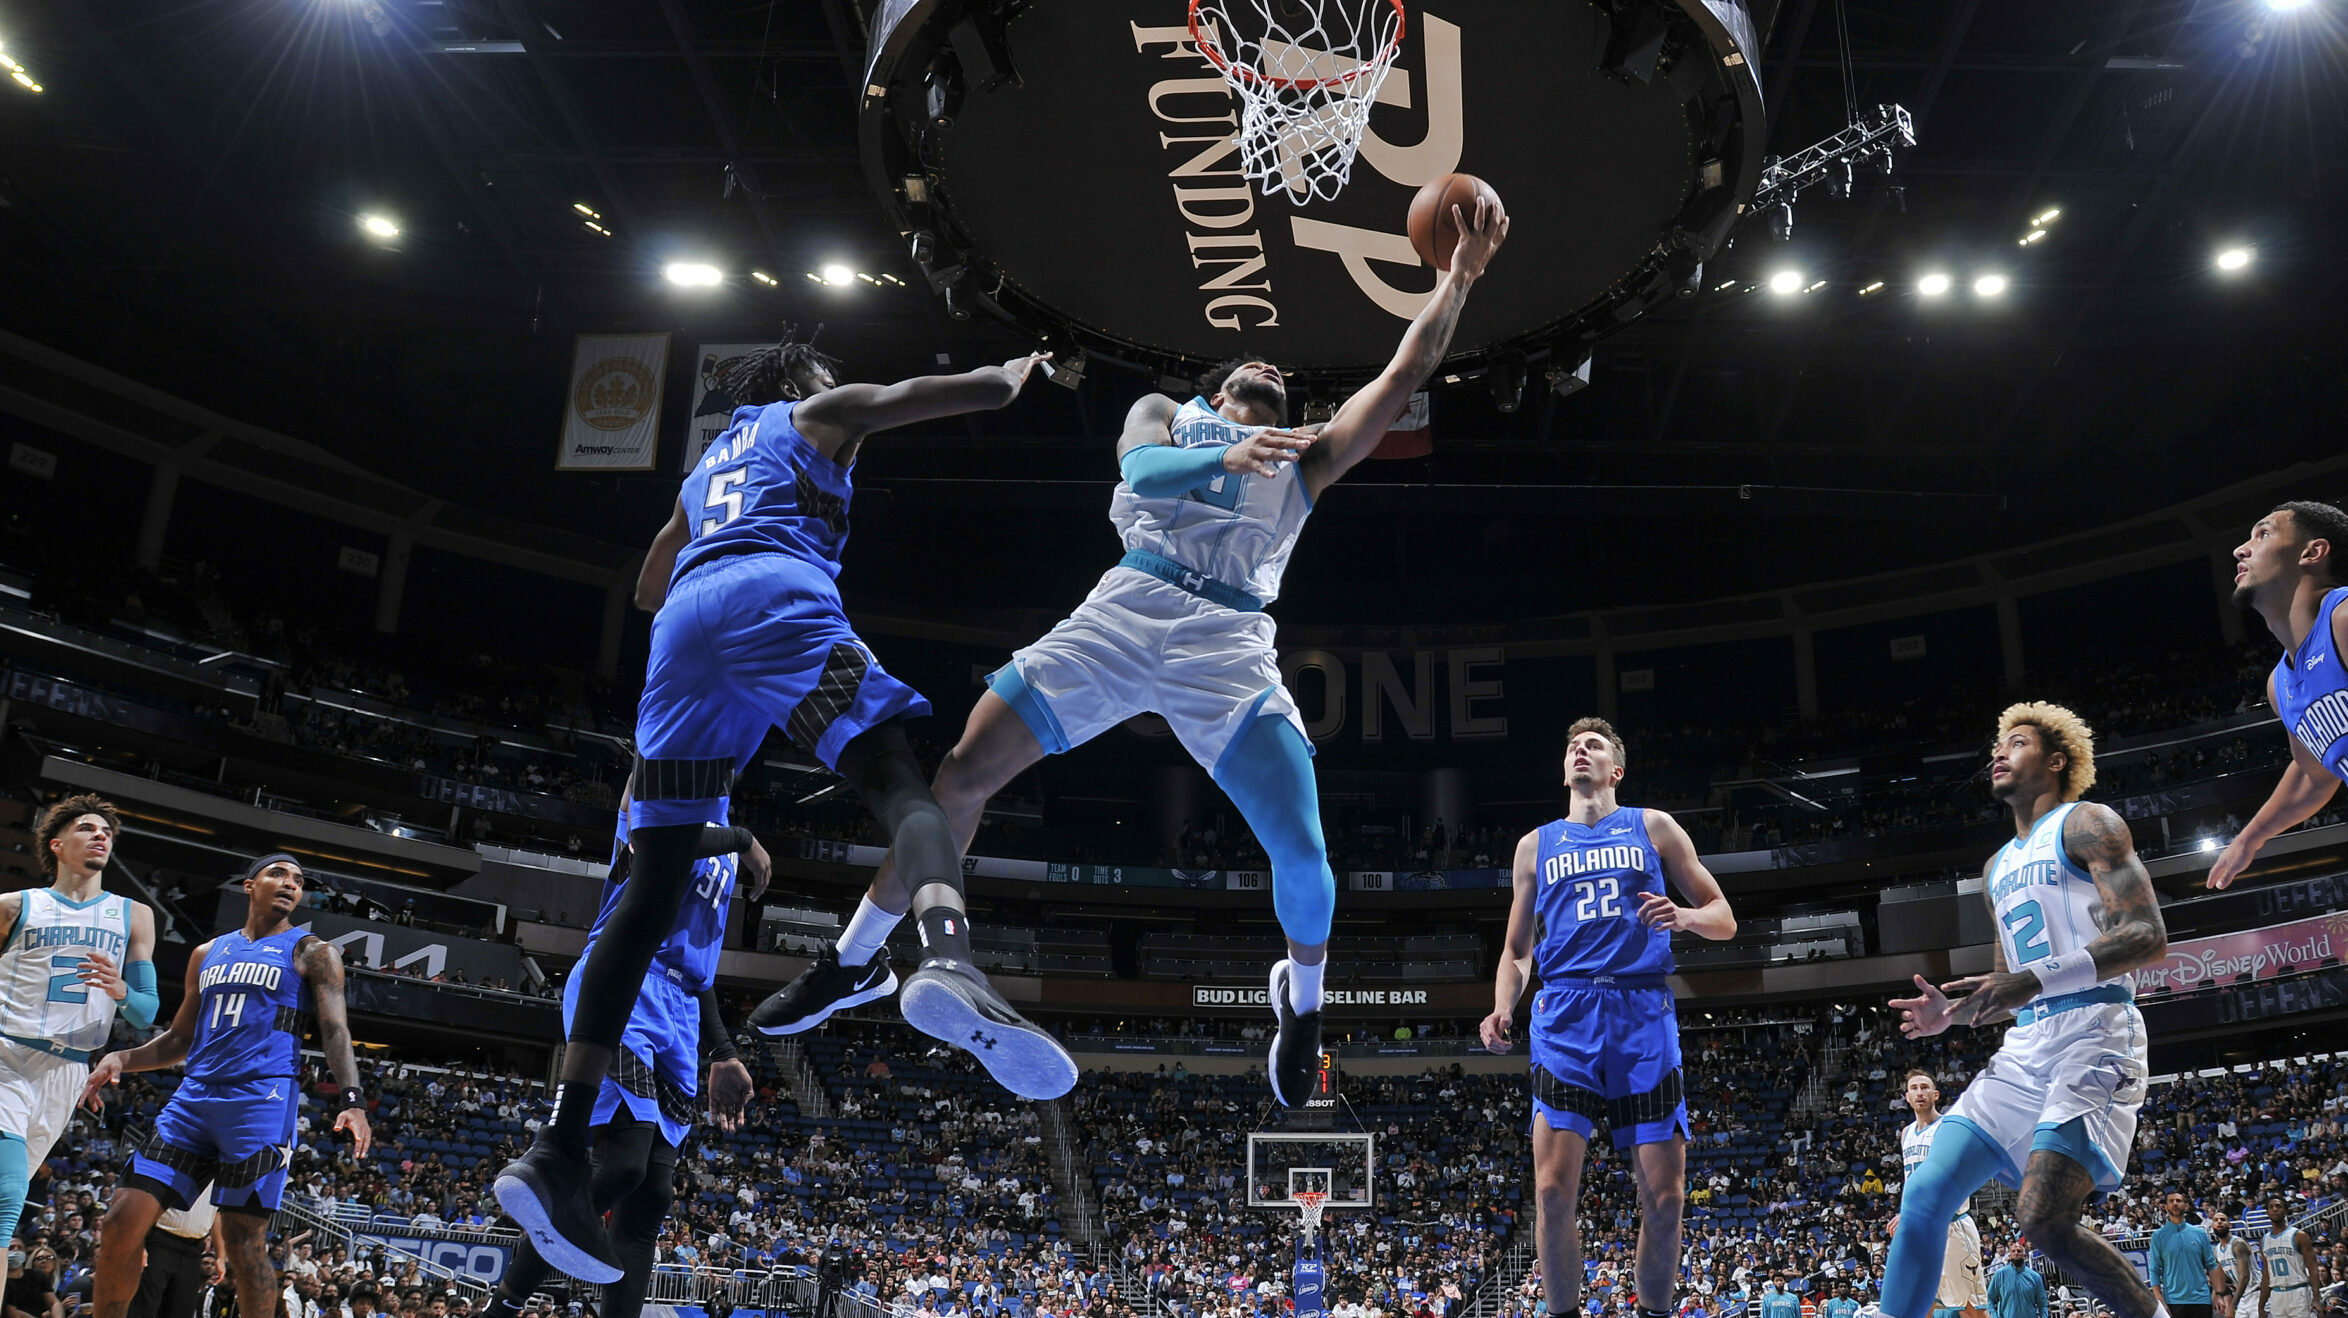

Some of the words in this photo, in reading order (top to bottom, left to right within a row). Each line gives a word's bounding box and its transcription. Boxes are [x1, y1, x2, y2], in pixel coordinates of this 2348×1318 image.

[1130, 17, 1280, 332] FUNDING
[574, 443, 613, 457] Amway
[612, 447, 640, 455] CENTER
[705, 421, 760, 470] BAMBA
[702, 465, 748, 538] 5
[1050, 863, 1067, 873] TEAM
[1071, 866, 1080, 882] 0
[1113, 868, 1122, 883] 3
[1238, 872, 1258, 888] 106
[1362, 872, 1382, 888] 100
[1544, 845, 1645, 886] ORLANDO
[695, 855, 731, 911] 31
[1574, 876, 1623, 922] 22
[24, 926, 126, 958] CHARLOTTE
[2263, 933, 2333, 968] World
[47, 955, 92, 1005] 2
[199, 961, 282, 994] ORLANDO
[211, 993, 247, 1029] 14
[1197, 989, 1236, 1004] BUD
[1238, 989, 1270, 1005] LIG
[1323, 990, 1386, 1005] SELINE
[1389, 990, 1428, 1004] BAR
[1306, 1099, 1336, 1108] ISSOT
[2270, 1257, 2290, 1277] 10
